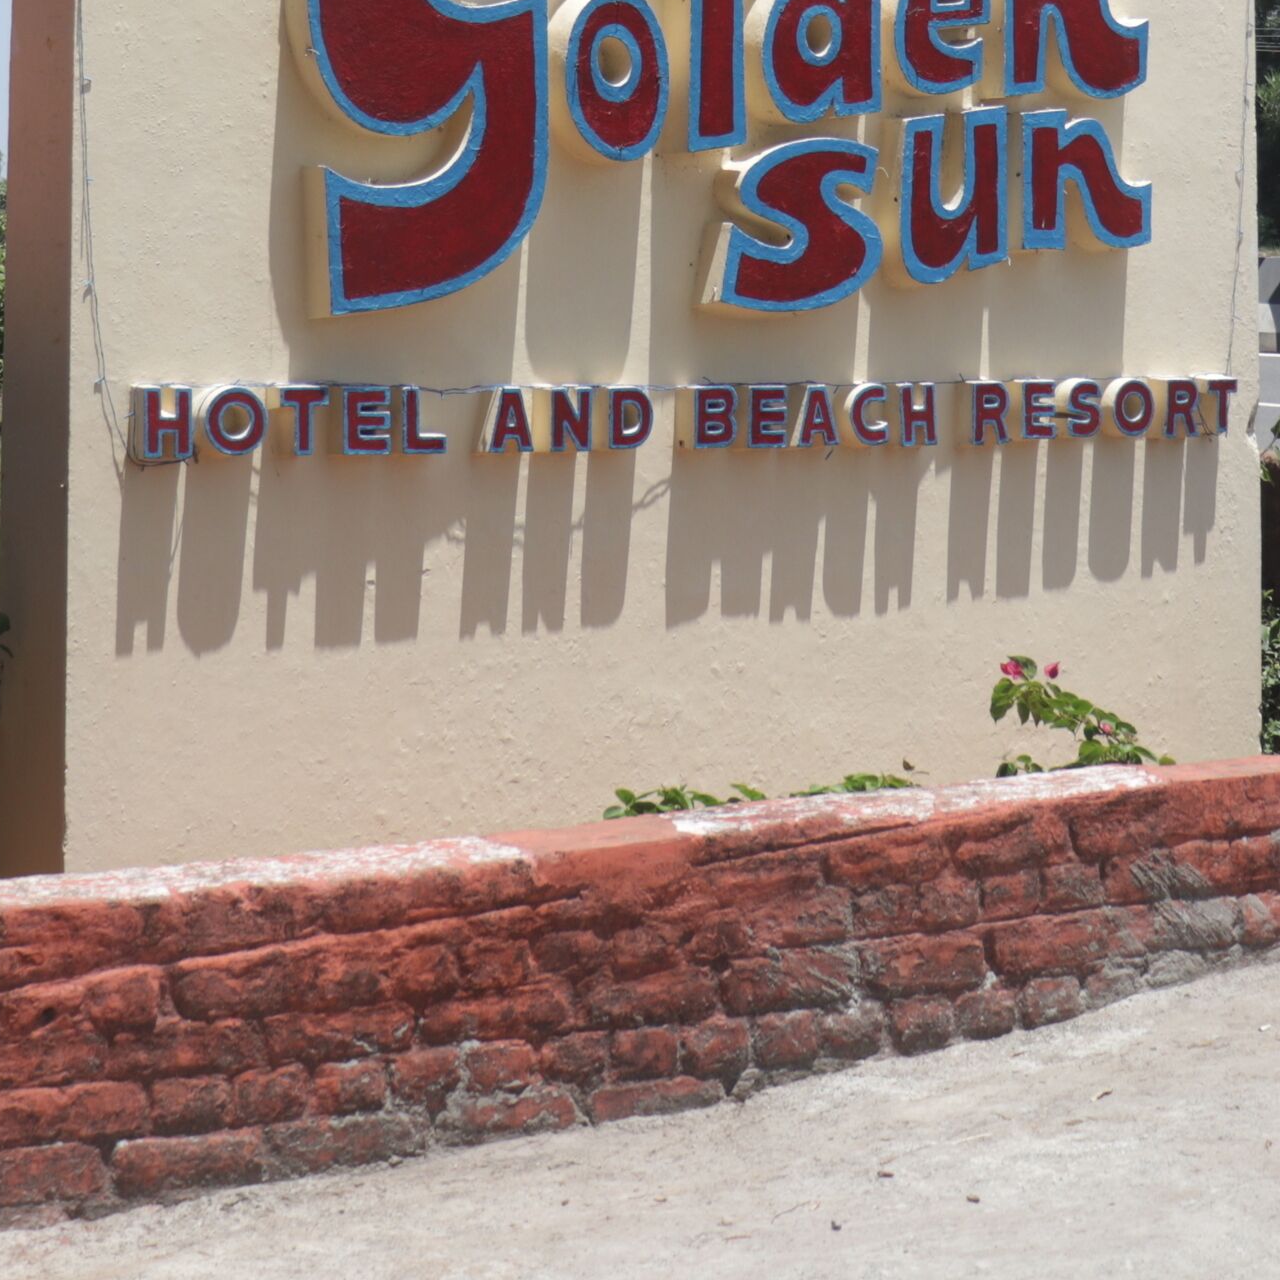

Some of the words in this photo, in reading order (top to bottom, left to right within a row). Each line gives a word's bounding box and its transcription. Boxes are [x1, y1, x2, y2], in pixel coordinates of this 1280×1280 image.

[143, 386, 448, 459] HOTEL
[490, 386, 654, 452] AND
[693, 382, 938, 449] BEACH
[972, 377, 1238, 446] RESORT
